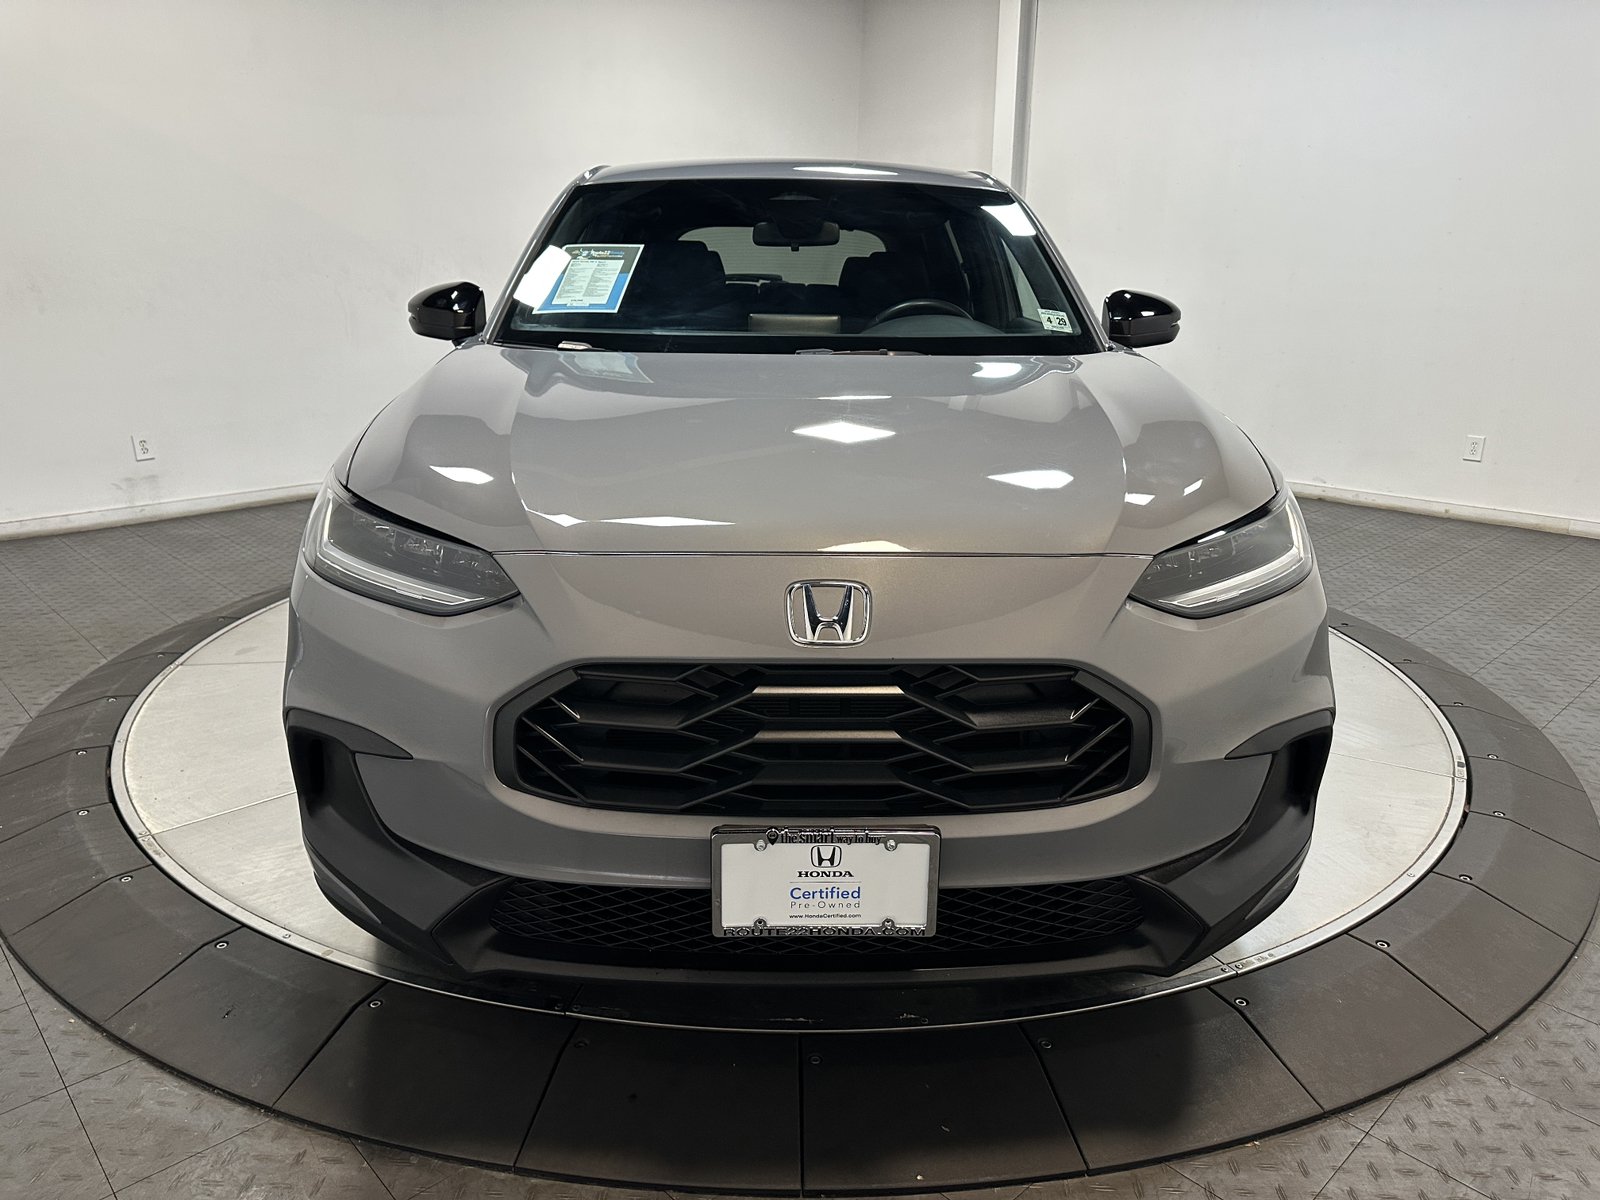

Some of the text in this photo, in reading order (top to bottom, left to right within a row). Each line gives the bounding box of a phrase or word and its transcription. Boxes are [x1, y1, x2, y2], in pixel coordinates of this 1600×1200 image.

[780, 826, 882, 845] the smart way to buy
[797, 870, 854, 878] HONDA
[789, 886, 861, 900] Certified
[790, 900, 861, 909] Pre-Owned
[723, 926, 926, 936] ROUTE22HONDA.COM
